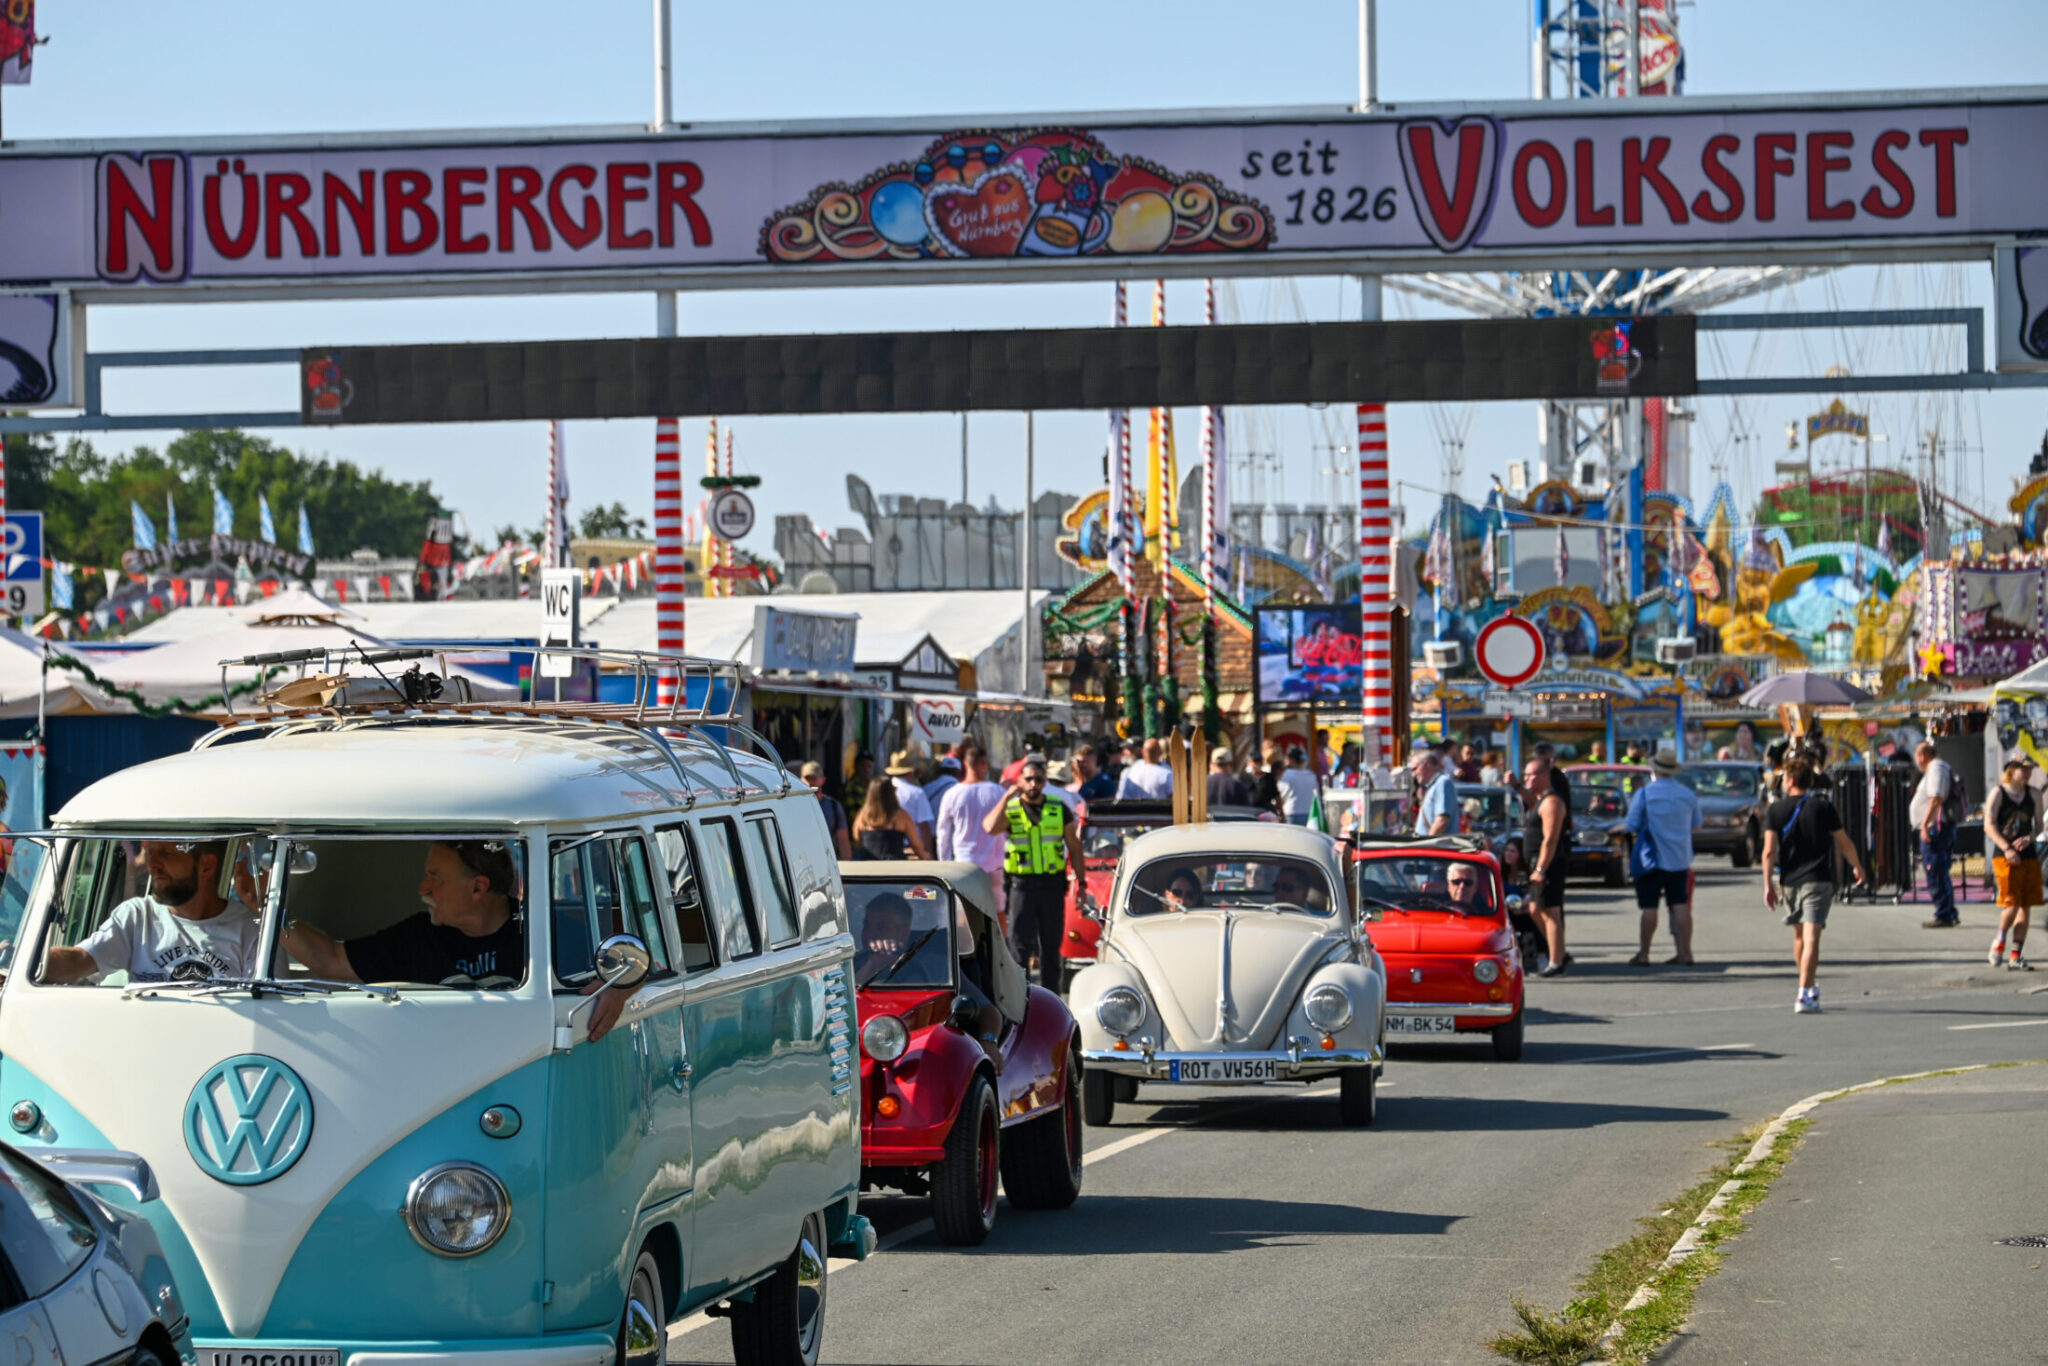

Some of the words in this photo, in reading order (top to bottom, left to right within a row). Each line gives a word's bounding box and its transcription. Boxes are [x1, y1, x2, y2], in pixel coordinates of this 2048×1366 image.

[1241, 139, 1339, 179] seit
[1408, 124, 1969, 243] VOLKSFEST
[106, 157, 713, 273] NÜRNBERGER
[950, 204, 988, 228] Gruß
[993, 200, 1020, 214] aus
[1286, 187, 1397, 225] 1826
[545, 584, 569, 616] WC
[153, 946, 182, 969] LIVE
[202, 951, 230, 975] RIDE
[1385, 1017, 1405, 1031] NM
[1413, 1017, 1432, 1032] BK
[1181, 1061, 1211, 1079] ROT
[191, 1059, 307, 1179] VW
